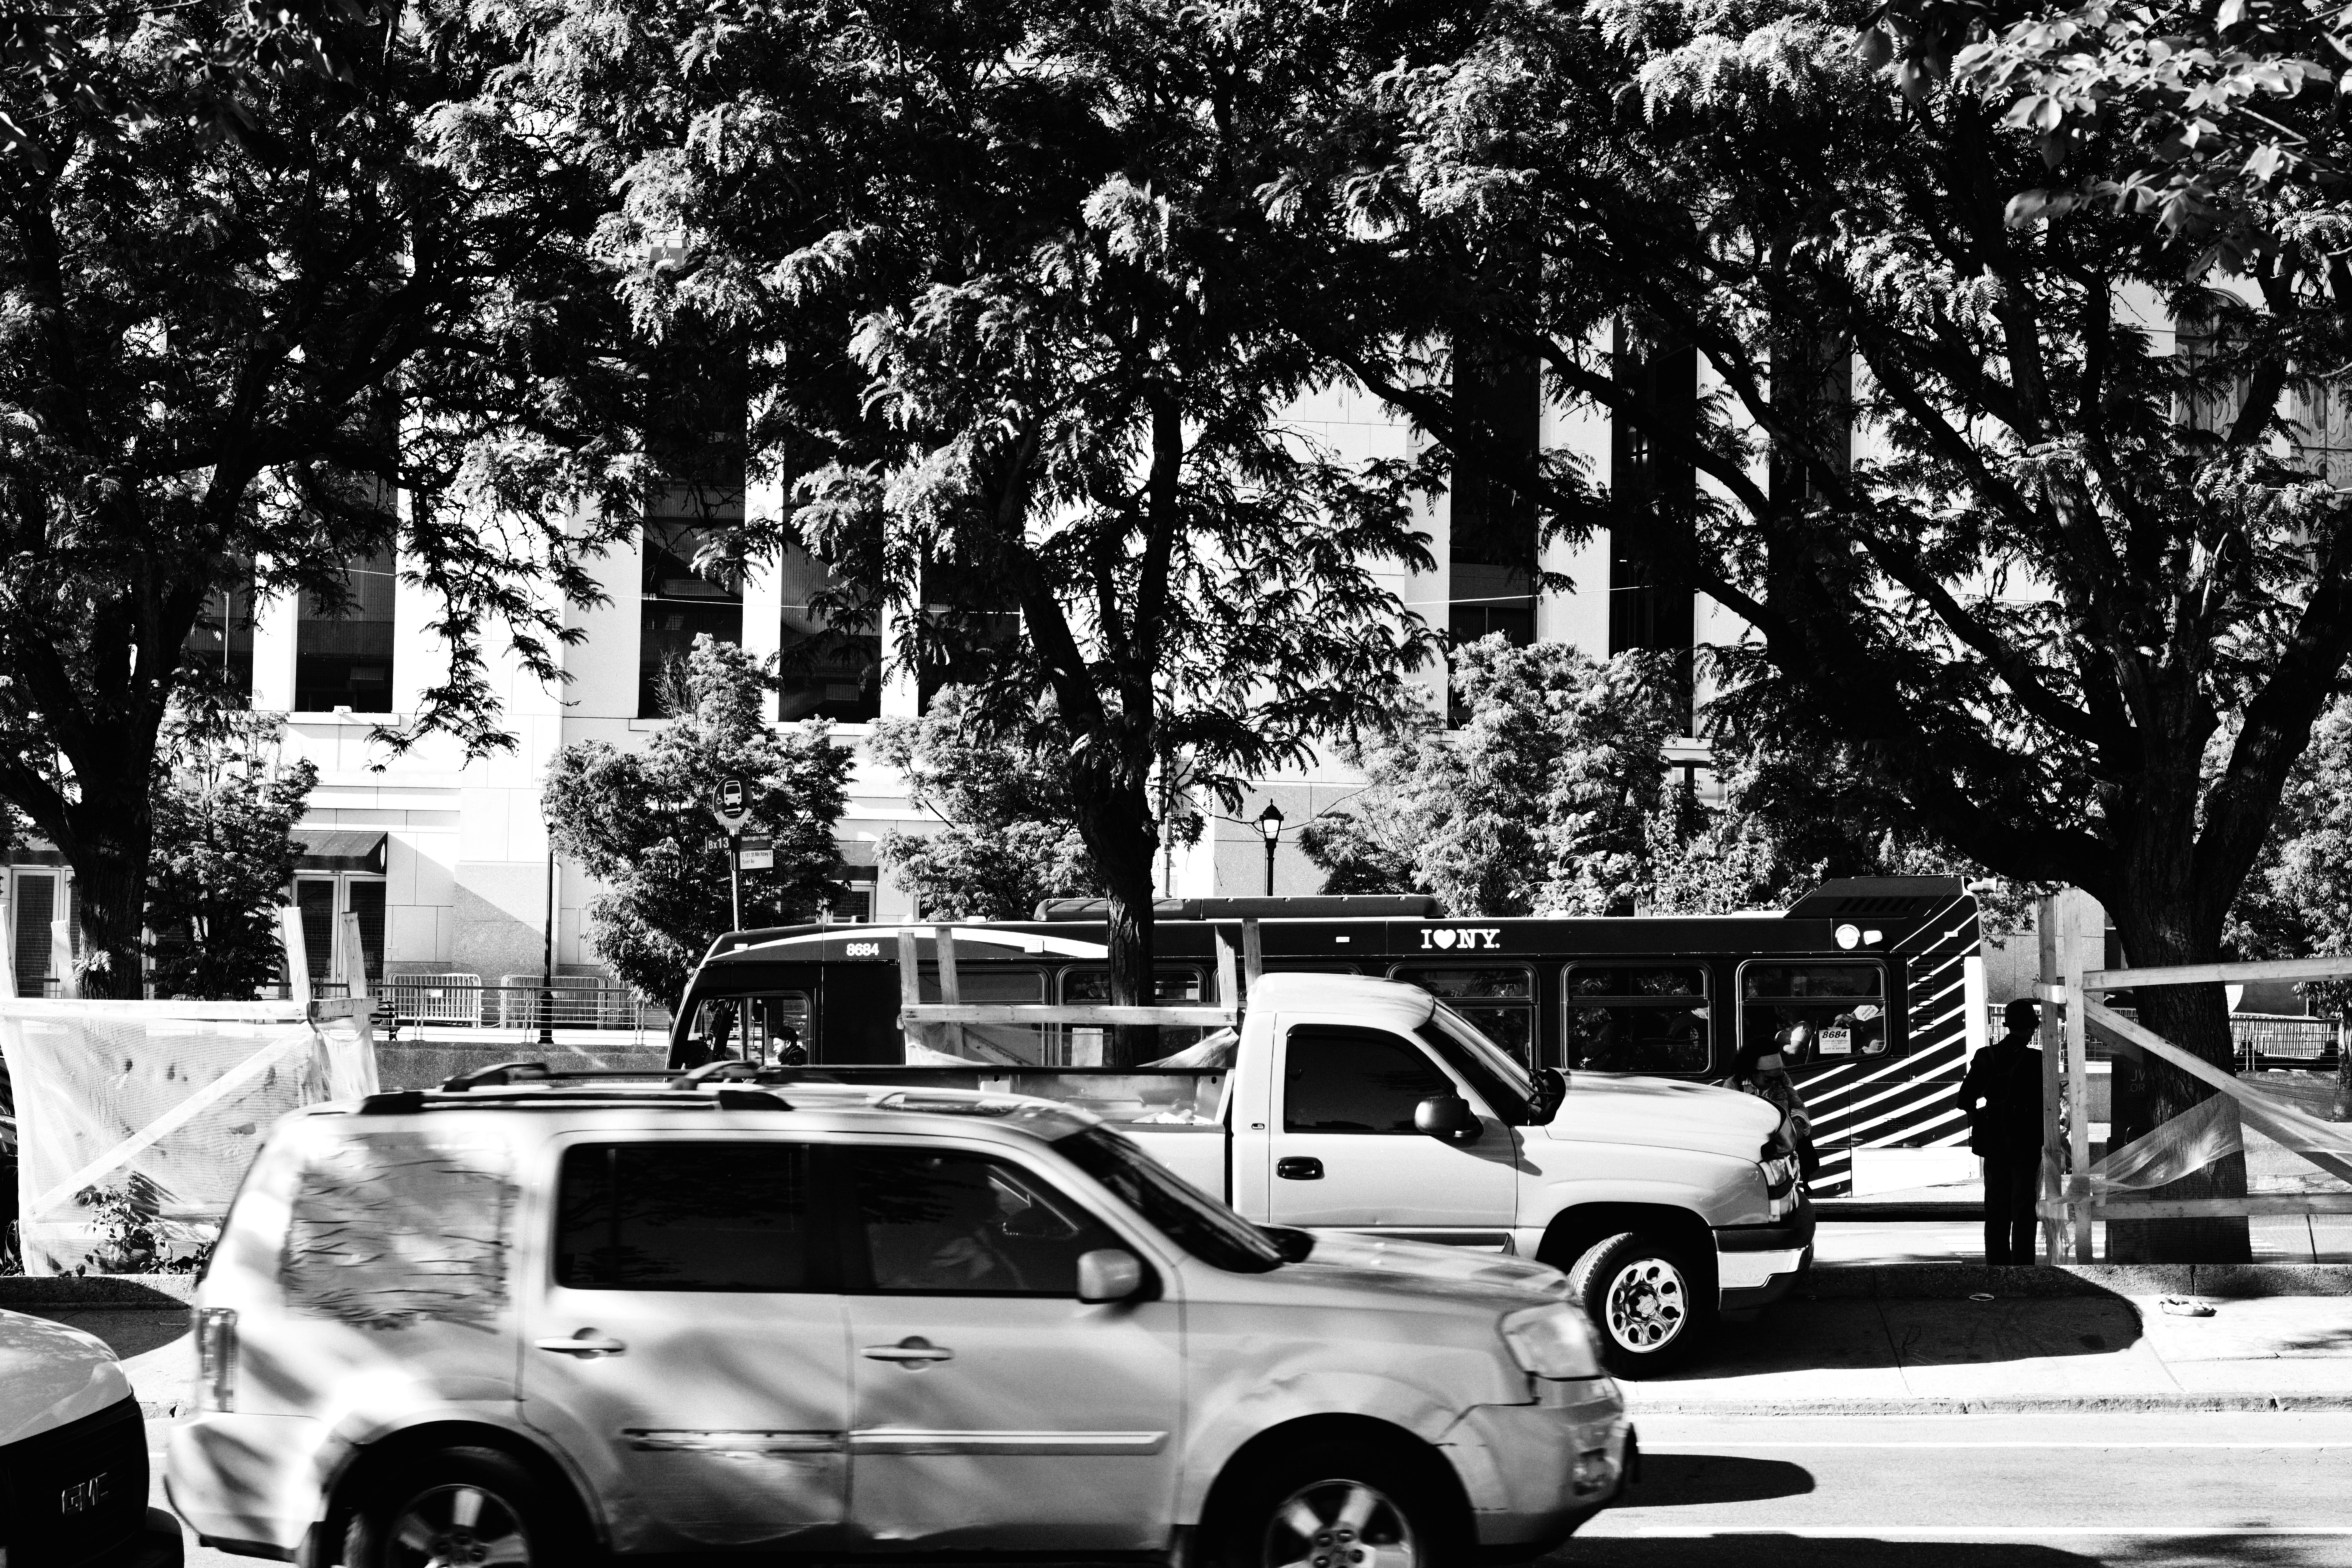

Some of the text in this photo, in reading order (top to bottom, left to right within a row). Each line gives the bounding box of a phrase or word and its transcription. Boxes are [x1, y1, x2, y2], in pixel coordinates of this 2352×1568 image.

[727, 811, 749, 825] STANDING
[708, 837, 729, 849] Bx13
[846, 943, 880, 956] 8684
[2128, 1083, 2146, 1092] .OR
